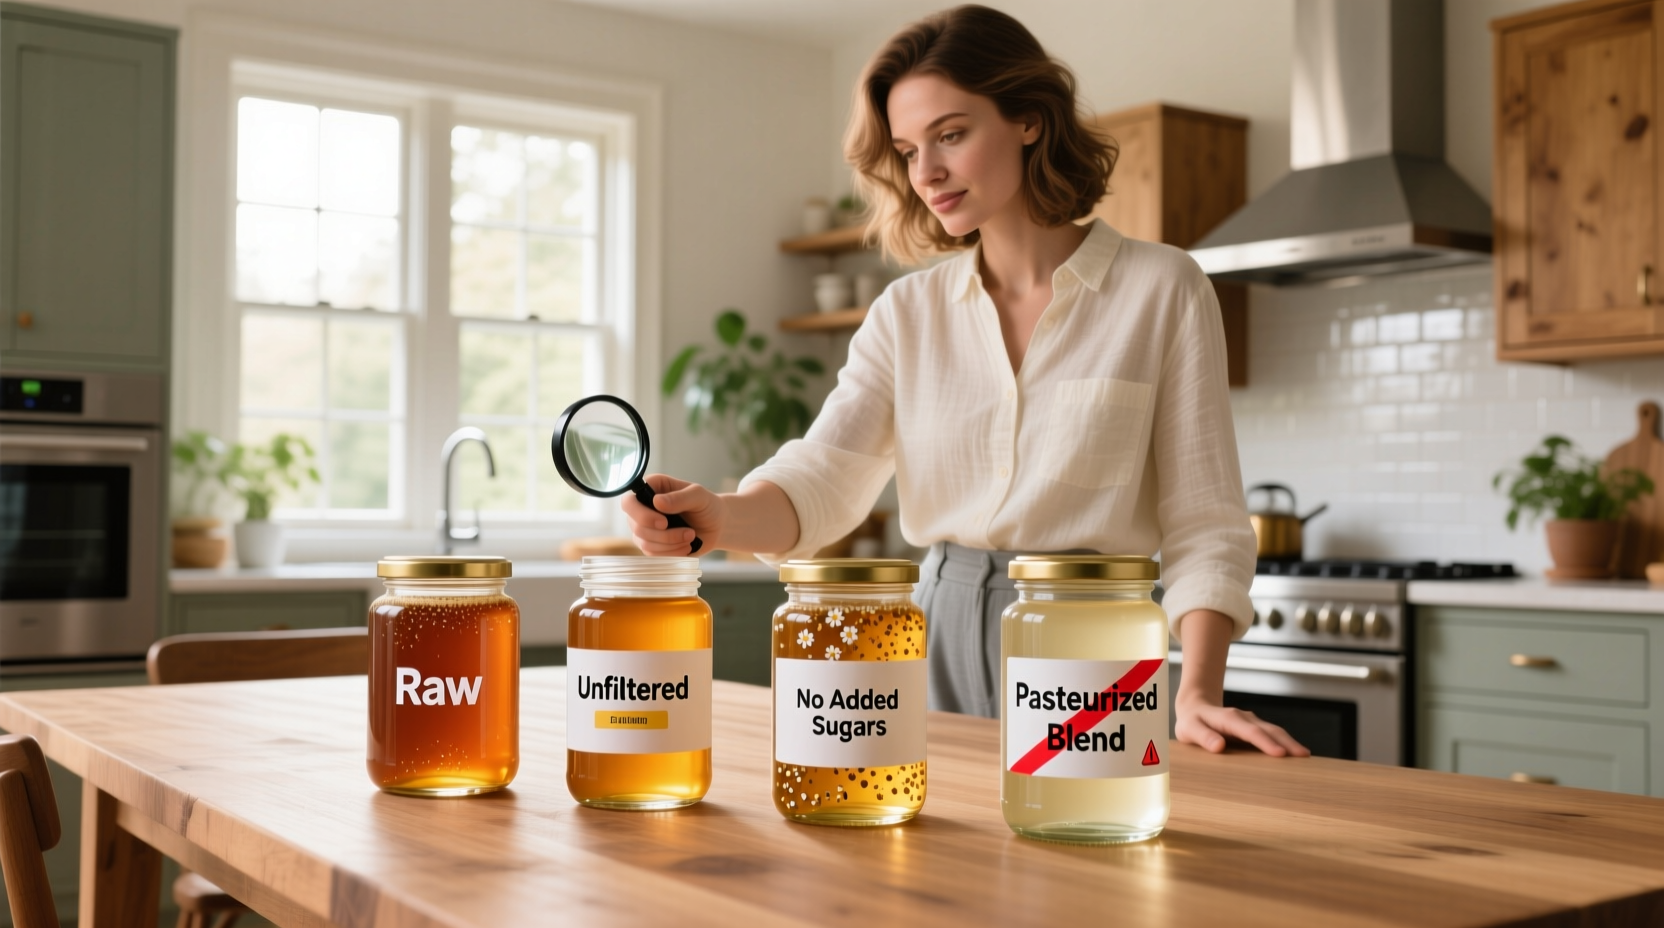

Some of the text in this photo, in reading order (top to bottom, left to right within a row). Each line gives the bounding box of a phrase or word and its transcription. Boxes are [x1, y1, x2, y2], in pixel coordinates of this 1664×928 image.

[395, 666, 483, 706] Raw
[577, 675, 689, 701] Unfiltered
[796, 688, 899, 710] No Added
[1016, 682, 1158, 712] Pasteurized
[812, 715, 887, 742] Sugars
[1047, 723, 1126, 752] Blend
